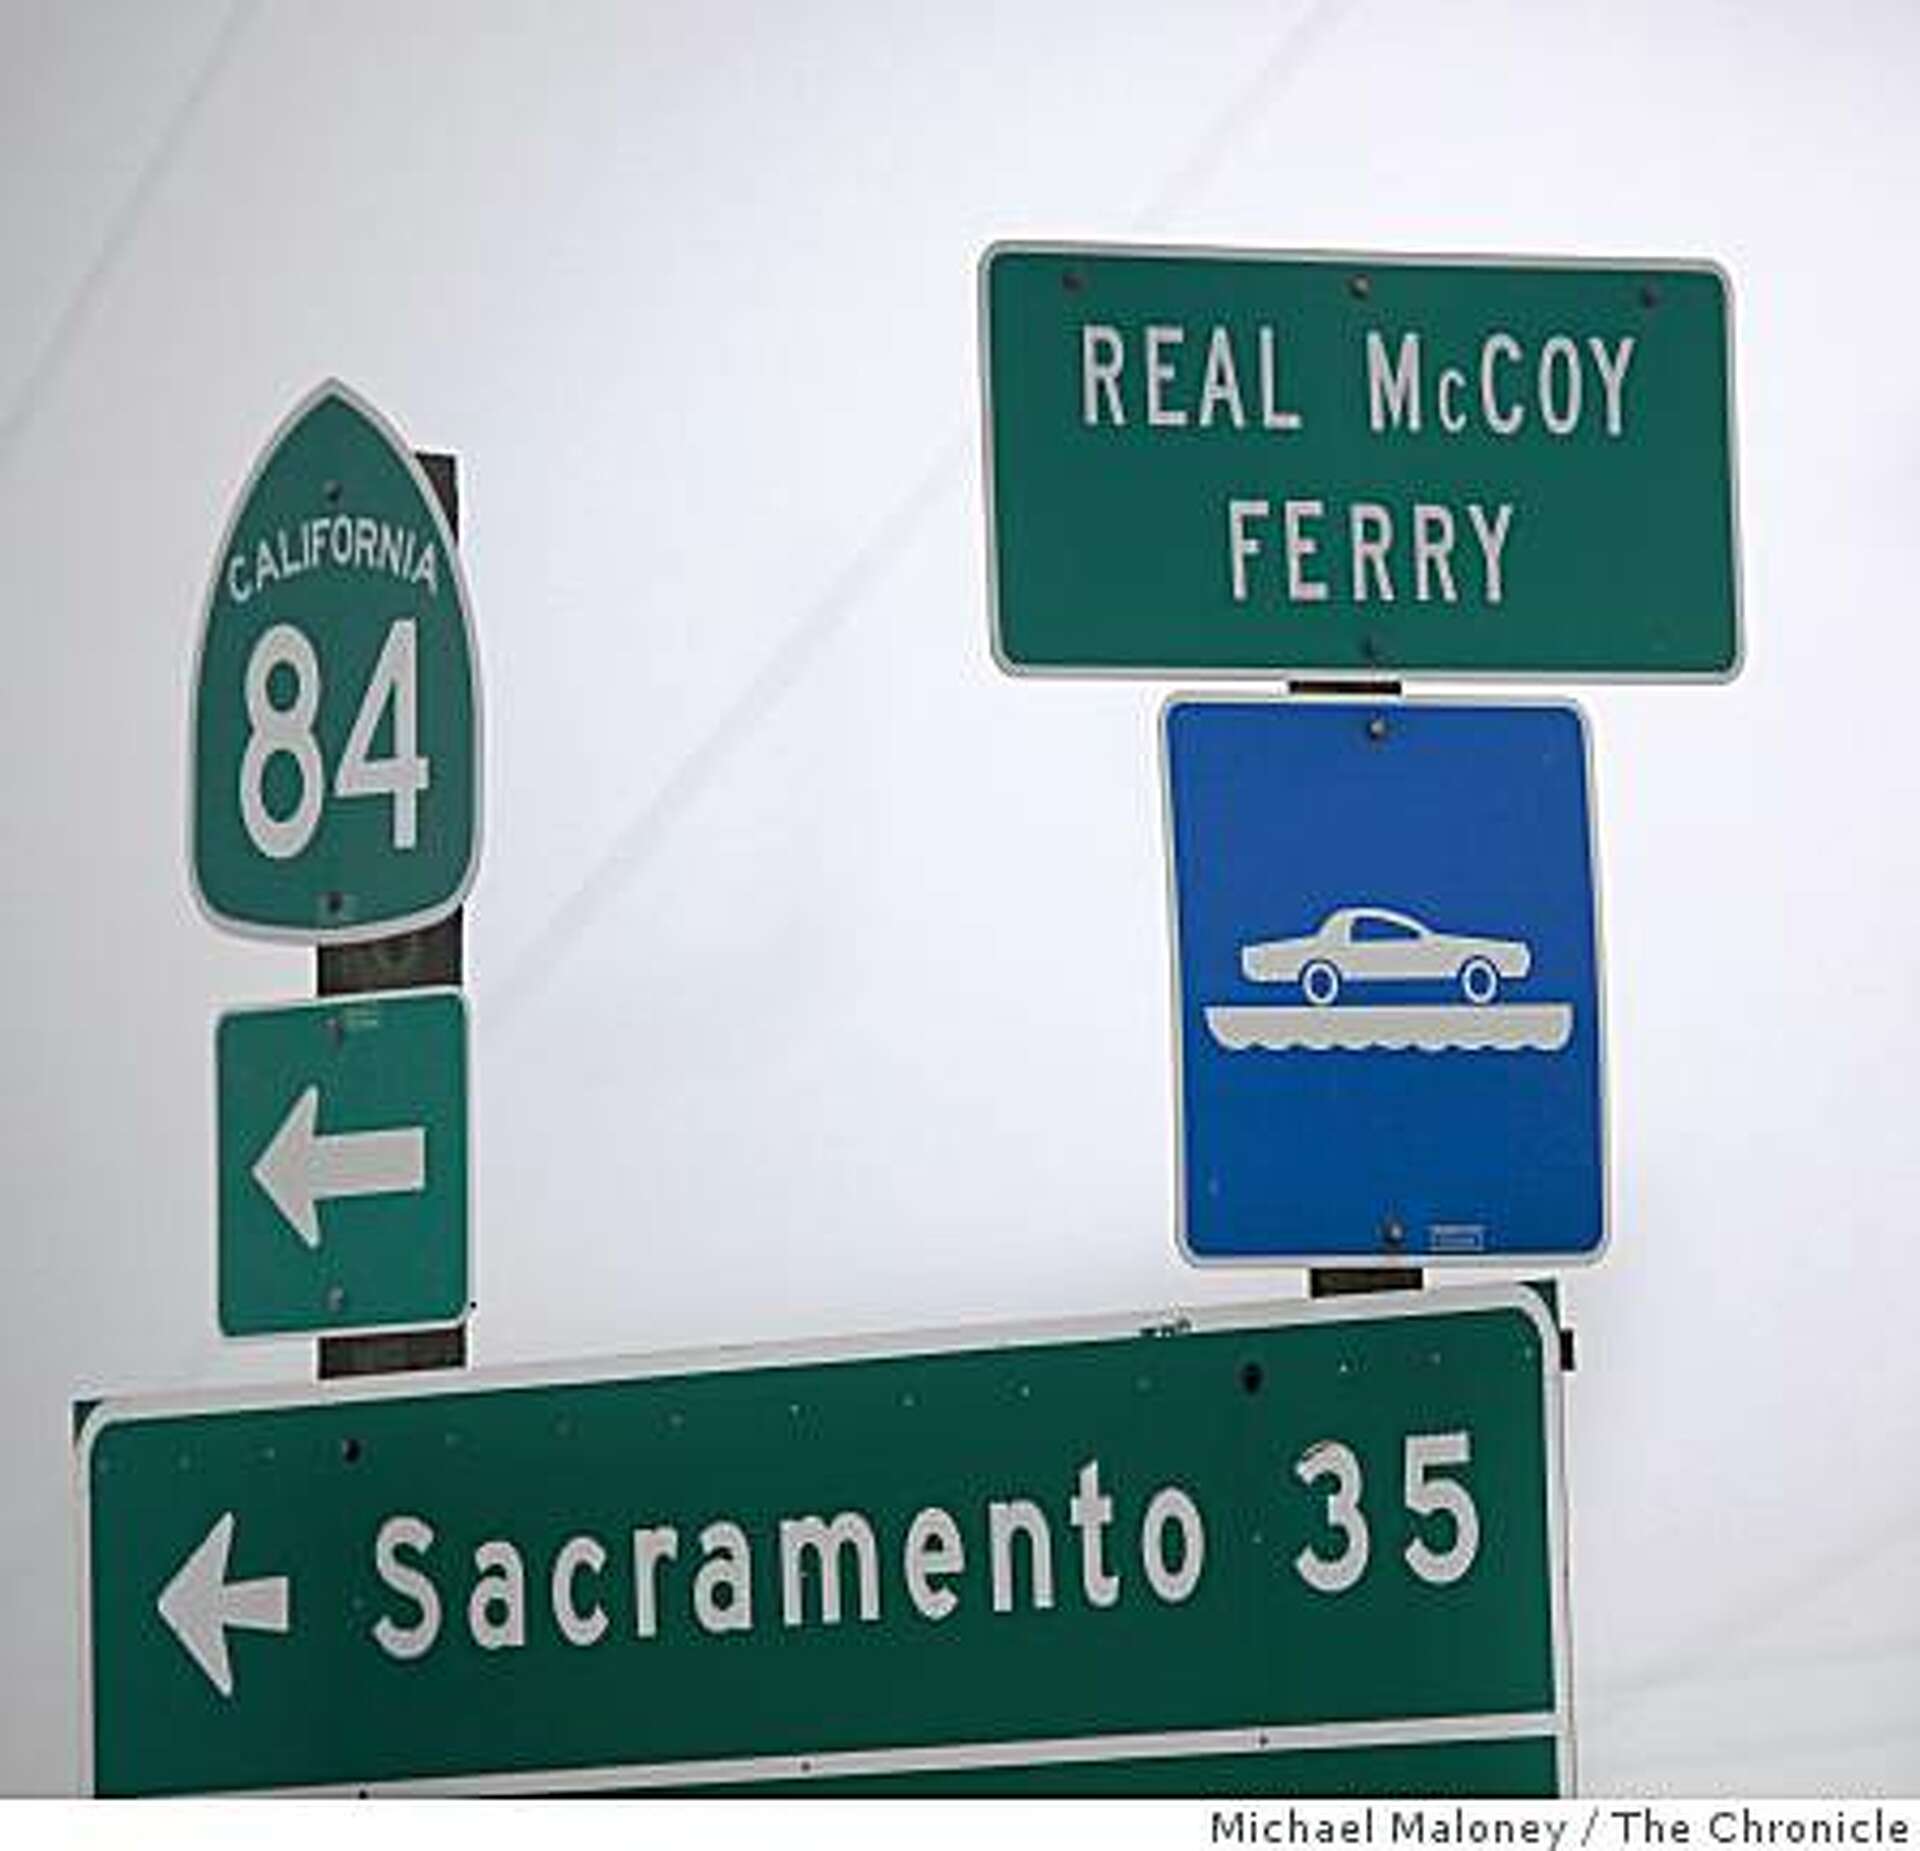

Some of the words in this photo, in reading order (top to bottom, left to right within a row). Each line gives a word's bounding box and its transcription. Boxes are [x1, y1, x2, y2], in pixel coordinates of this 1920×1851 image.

[1083, 325, 1301, 430] REAL
[1367, 332, 1636, 436] McCOY
[228, 515, 438, 605] CALIFORNIA
[1229, 499, 1514, 604] FERRY
[239, 617, 430, 860] 84
[372, 1460, 1206, 1661] Sacramento
[1293, 1432, 1482, 1592] 35
